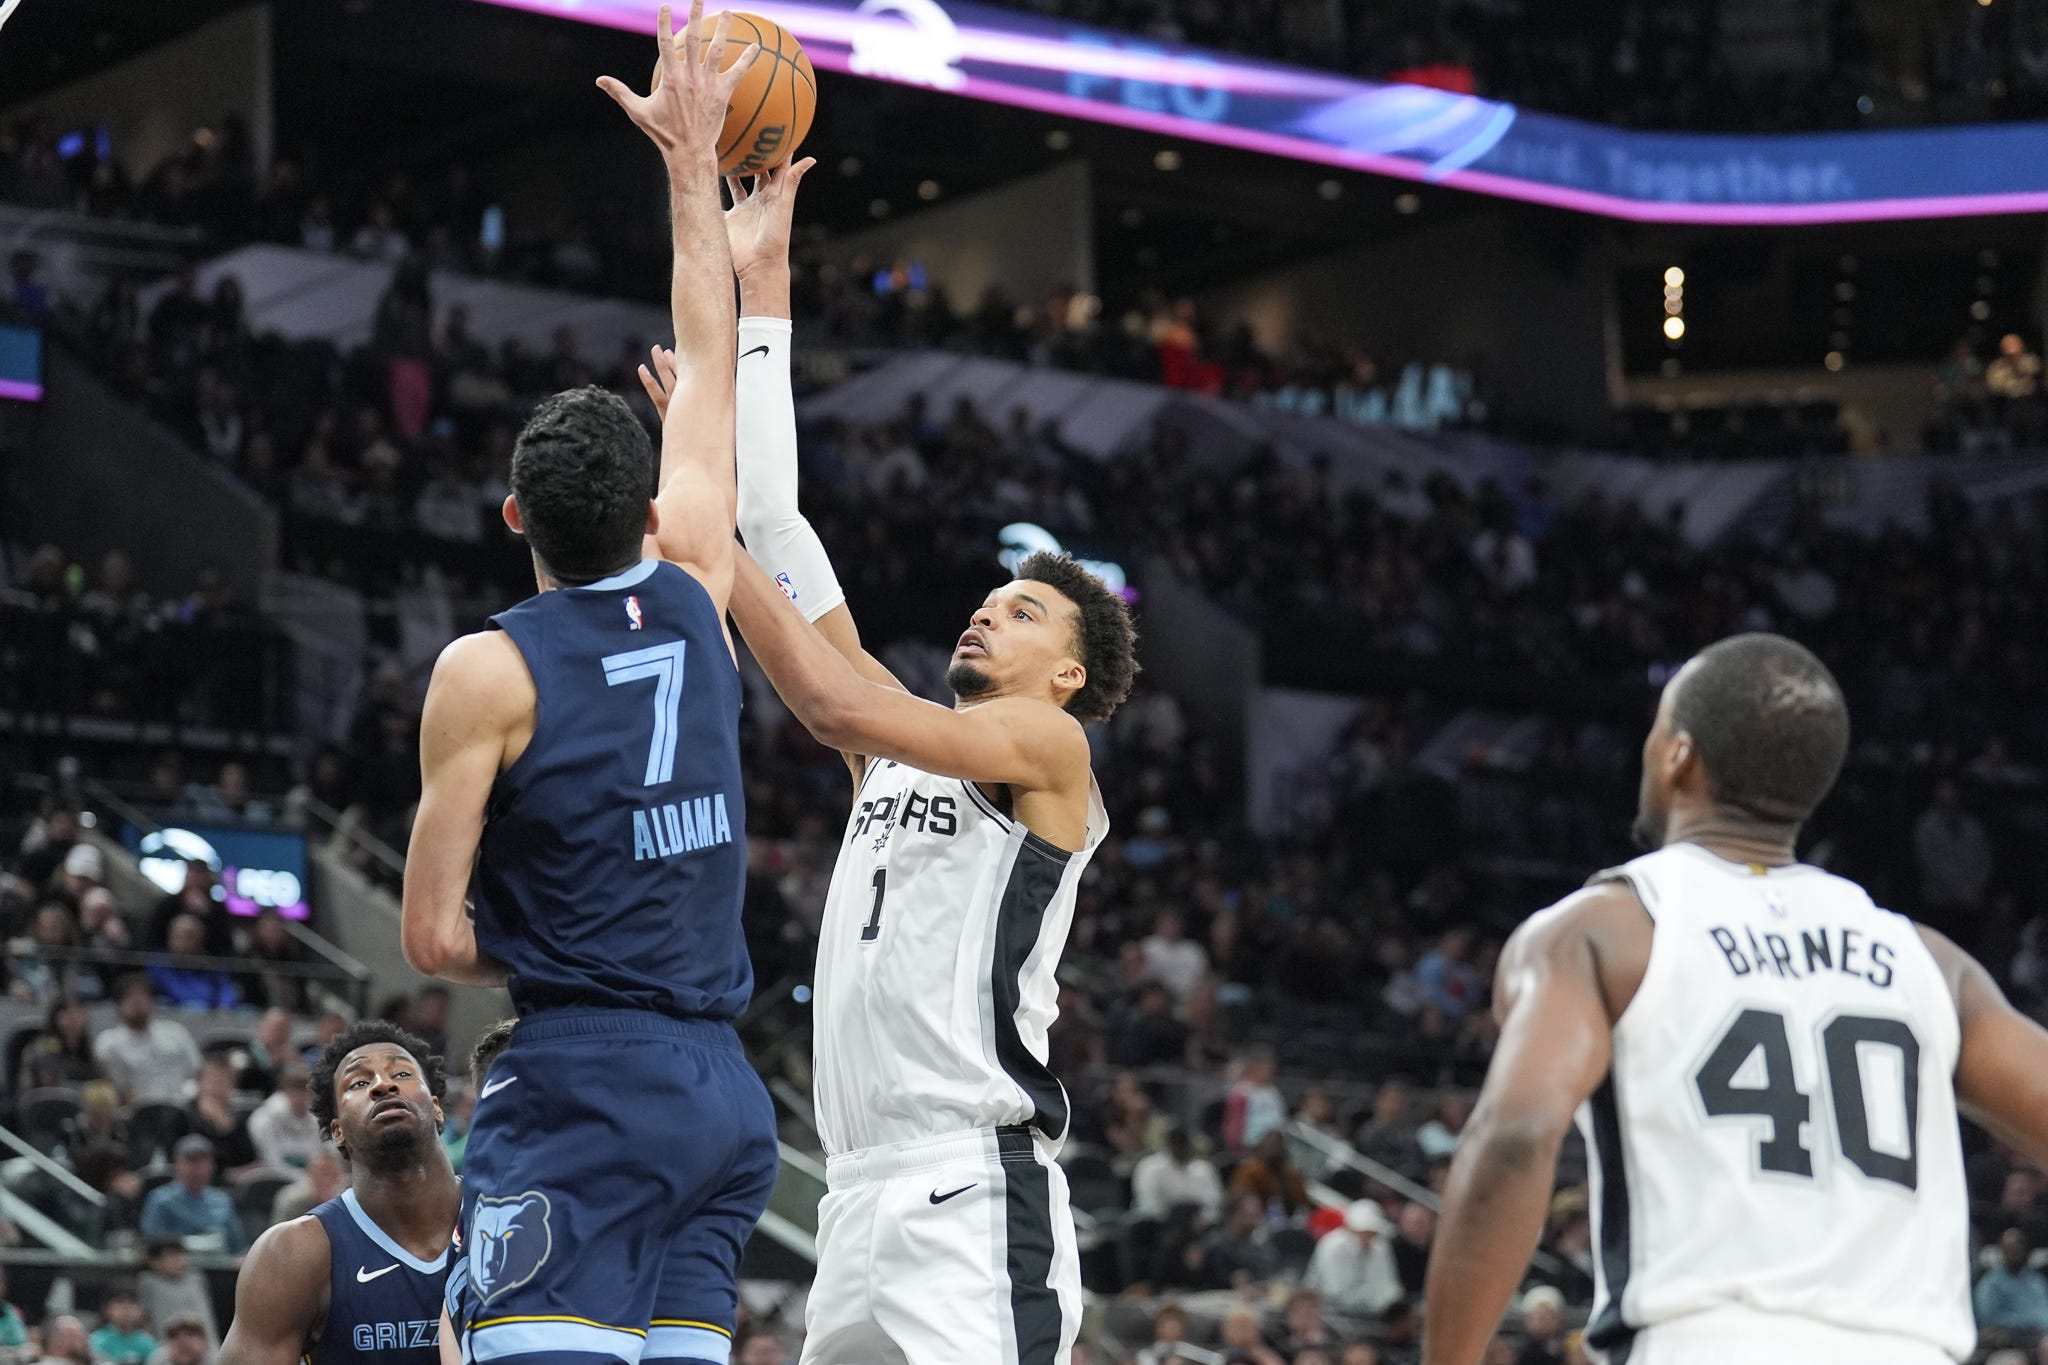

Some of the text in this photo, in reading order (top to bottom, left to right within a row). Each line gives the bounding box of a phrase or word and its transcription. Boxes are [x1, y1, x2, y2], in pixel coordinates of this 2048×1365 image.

[728, 125, 786, 174] Wil
[601, 639, 686, 787] 7
[633, 793, 732, 861] ALDAMA
[851, 788, 957, 843] SPRS
[860, 867, 887, 942] 1
[1709, 925, 1895, 988] BARNES
[1694, 1007, 1921, 1193] 40
